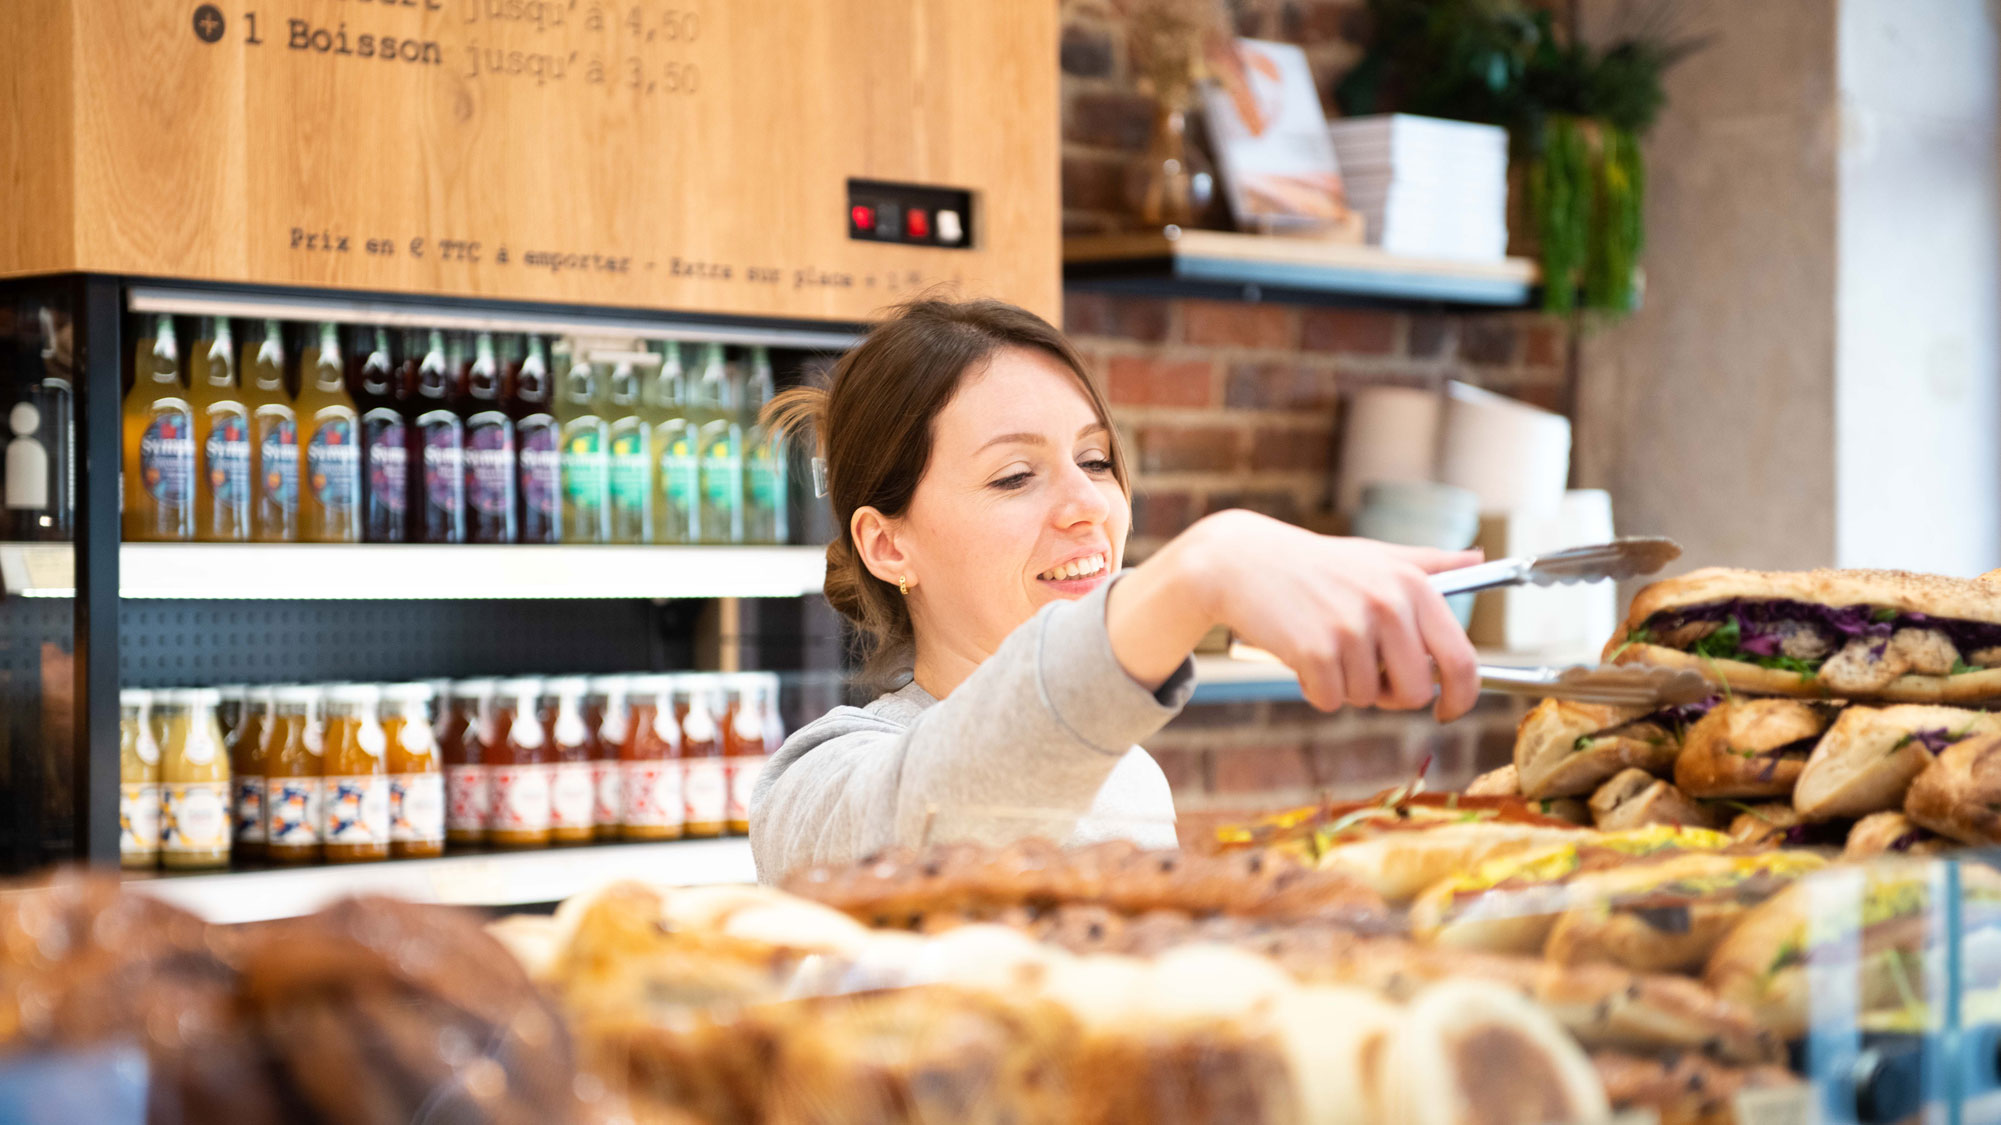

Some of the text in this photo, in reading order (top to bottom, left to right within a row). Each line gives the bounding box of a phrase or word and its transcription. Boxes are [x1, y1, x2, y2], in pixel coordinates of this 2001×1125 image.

[624, 5, 700, 43] 4,50
[243, 12, 264, 45] 1
[287, 17, 442, 65] Boisson
[624, 56, 700, 95] 3,50
[289, 227, 350, 253] Prix
[365, 235, 395, 257] en
[438, 238, 483, 263] TTC
[522, 249, 632, 272] emporter
